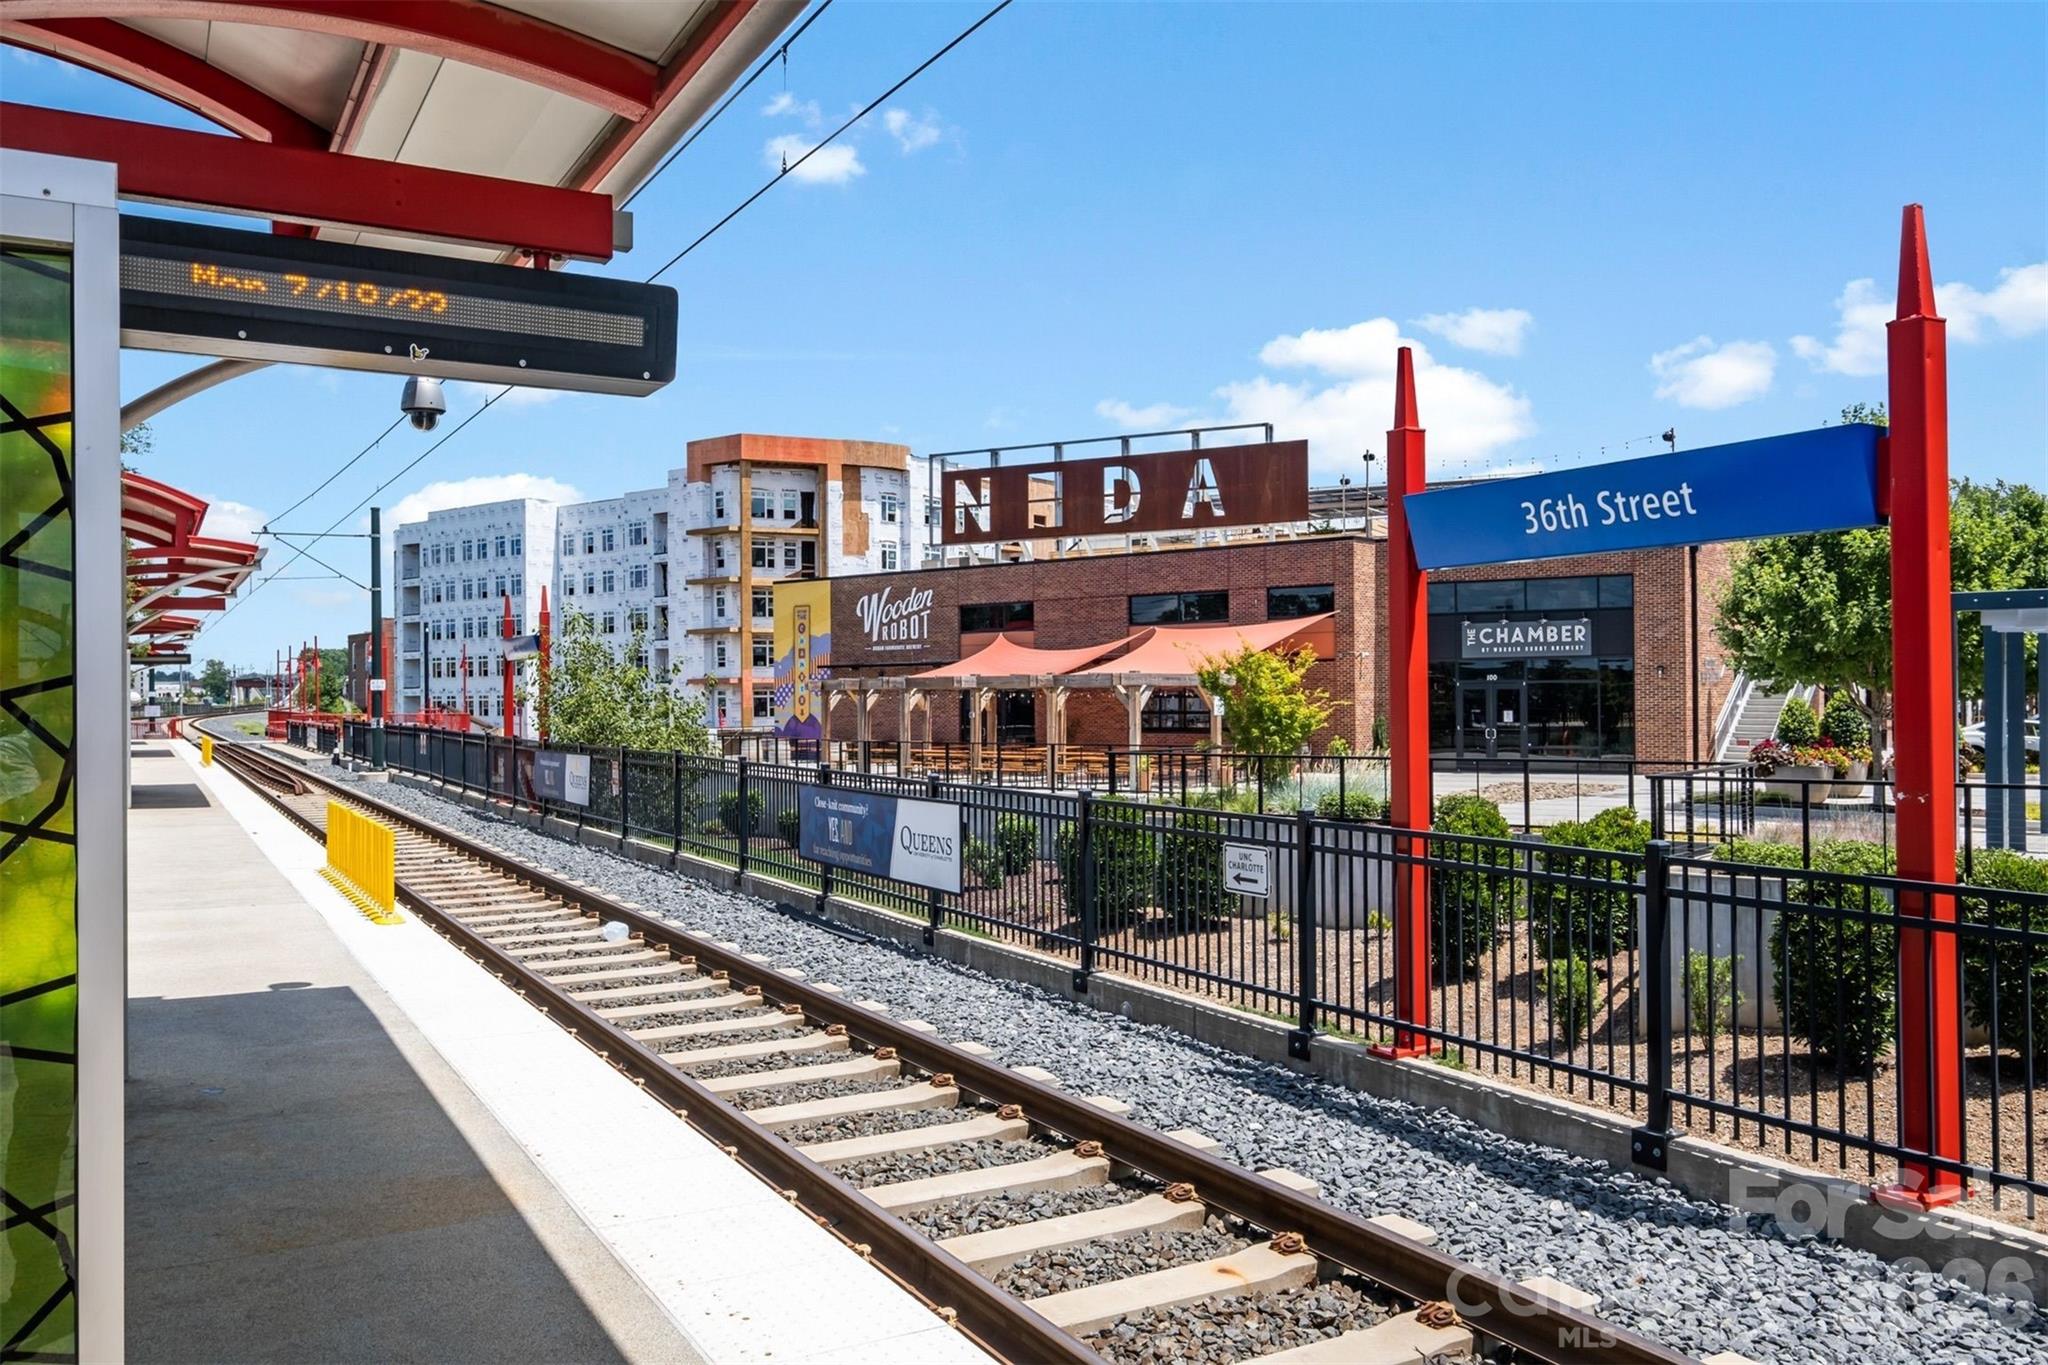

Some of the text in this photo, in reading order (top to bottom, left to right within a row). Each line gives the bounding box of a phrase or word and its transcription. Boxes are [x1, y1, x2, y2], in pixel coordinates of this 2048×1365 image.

[1520, 481, 1697, 534] 36th Street
[856, 586, 934, 642] Wooden
[882, 610, 931, 641] ROBOT
[1466, 625, 1586, 646] THE CHAMBER
[900, 825, 953, 856] QUEENS
[1228, 860, 1264, 874] CHARLOTTE
[1239, 853, 1252, 862] UNC
